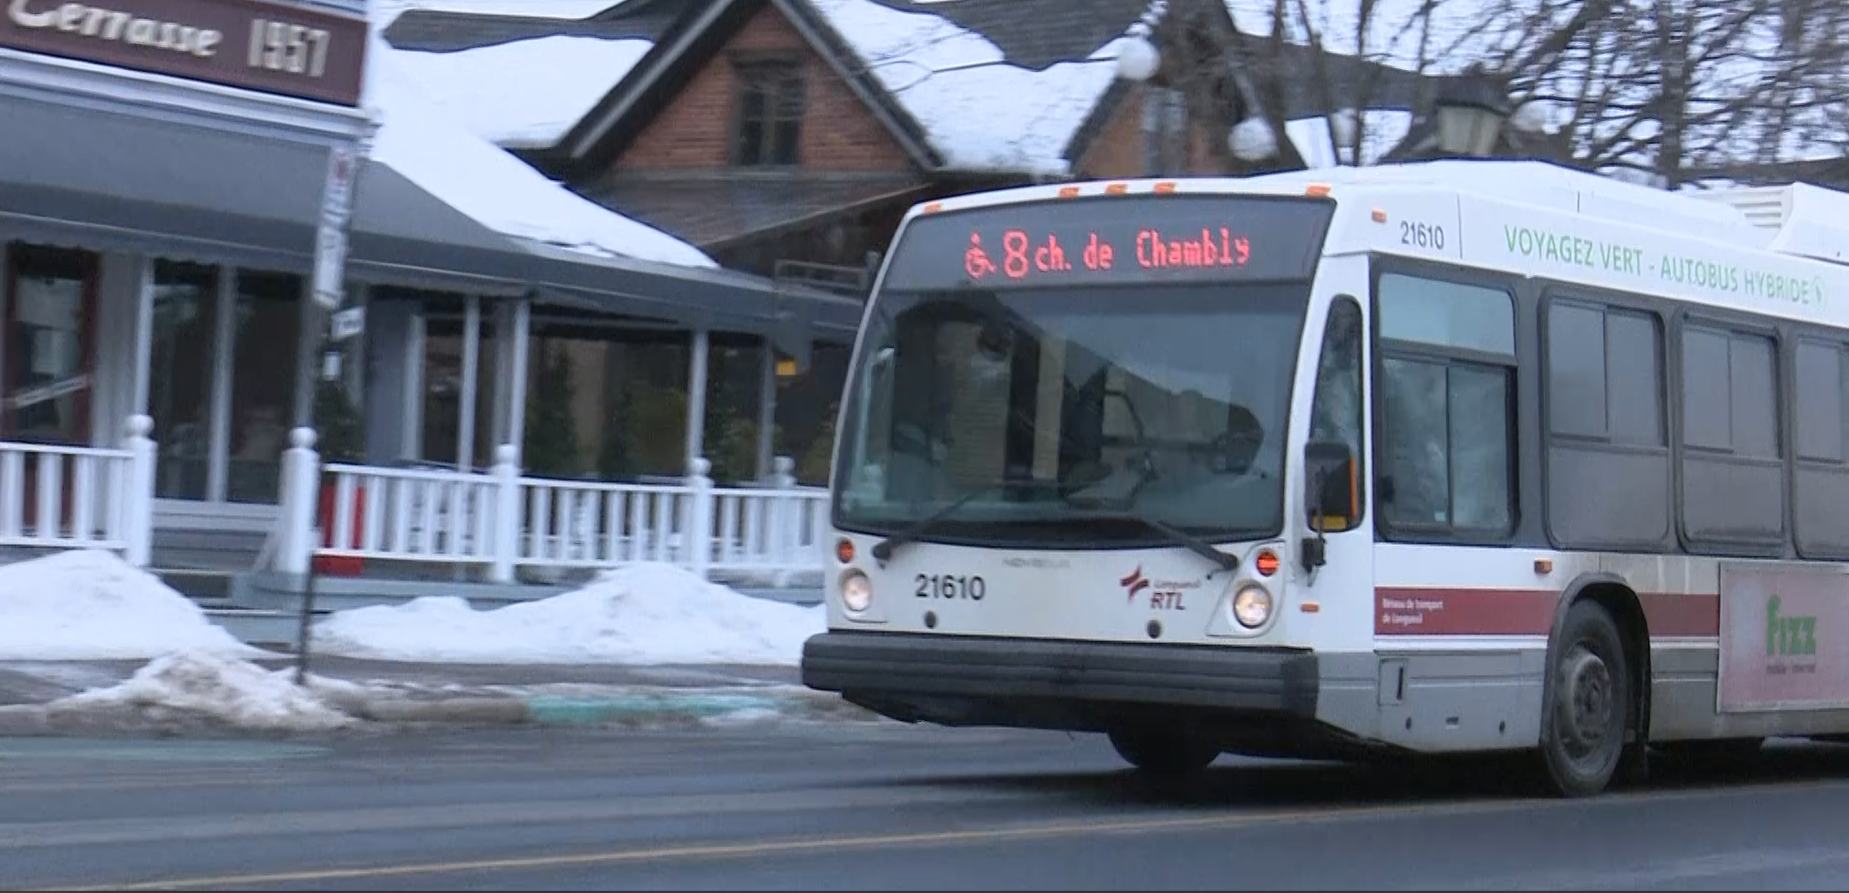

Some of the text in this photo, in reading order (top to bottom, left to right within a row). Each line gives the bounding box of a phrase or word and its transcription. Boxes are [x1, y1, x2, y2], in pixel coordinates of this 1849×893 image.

[248, 18, 331, 78] 1957
[1003, 226, 1249, 279] 8 ch. de Chambly
[1400, 220, 1445, 250] 21610
[1504, 224, 1594, 266] VOYAGEZ
[1600, 241, 1643, 276] VERT
[1660, 254, 1738, 293] AUTOBUS
[1744, 270, 1810, 305] HYBRIDE
[915, 573, 986, 601] 21610
[1151, 592, 1186, 611] RTL
